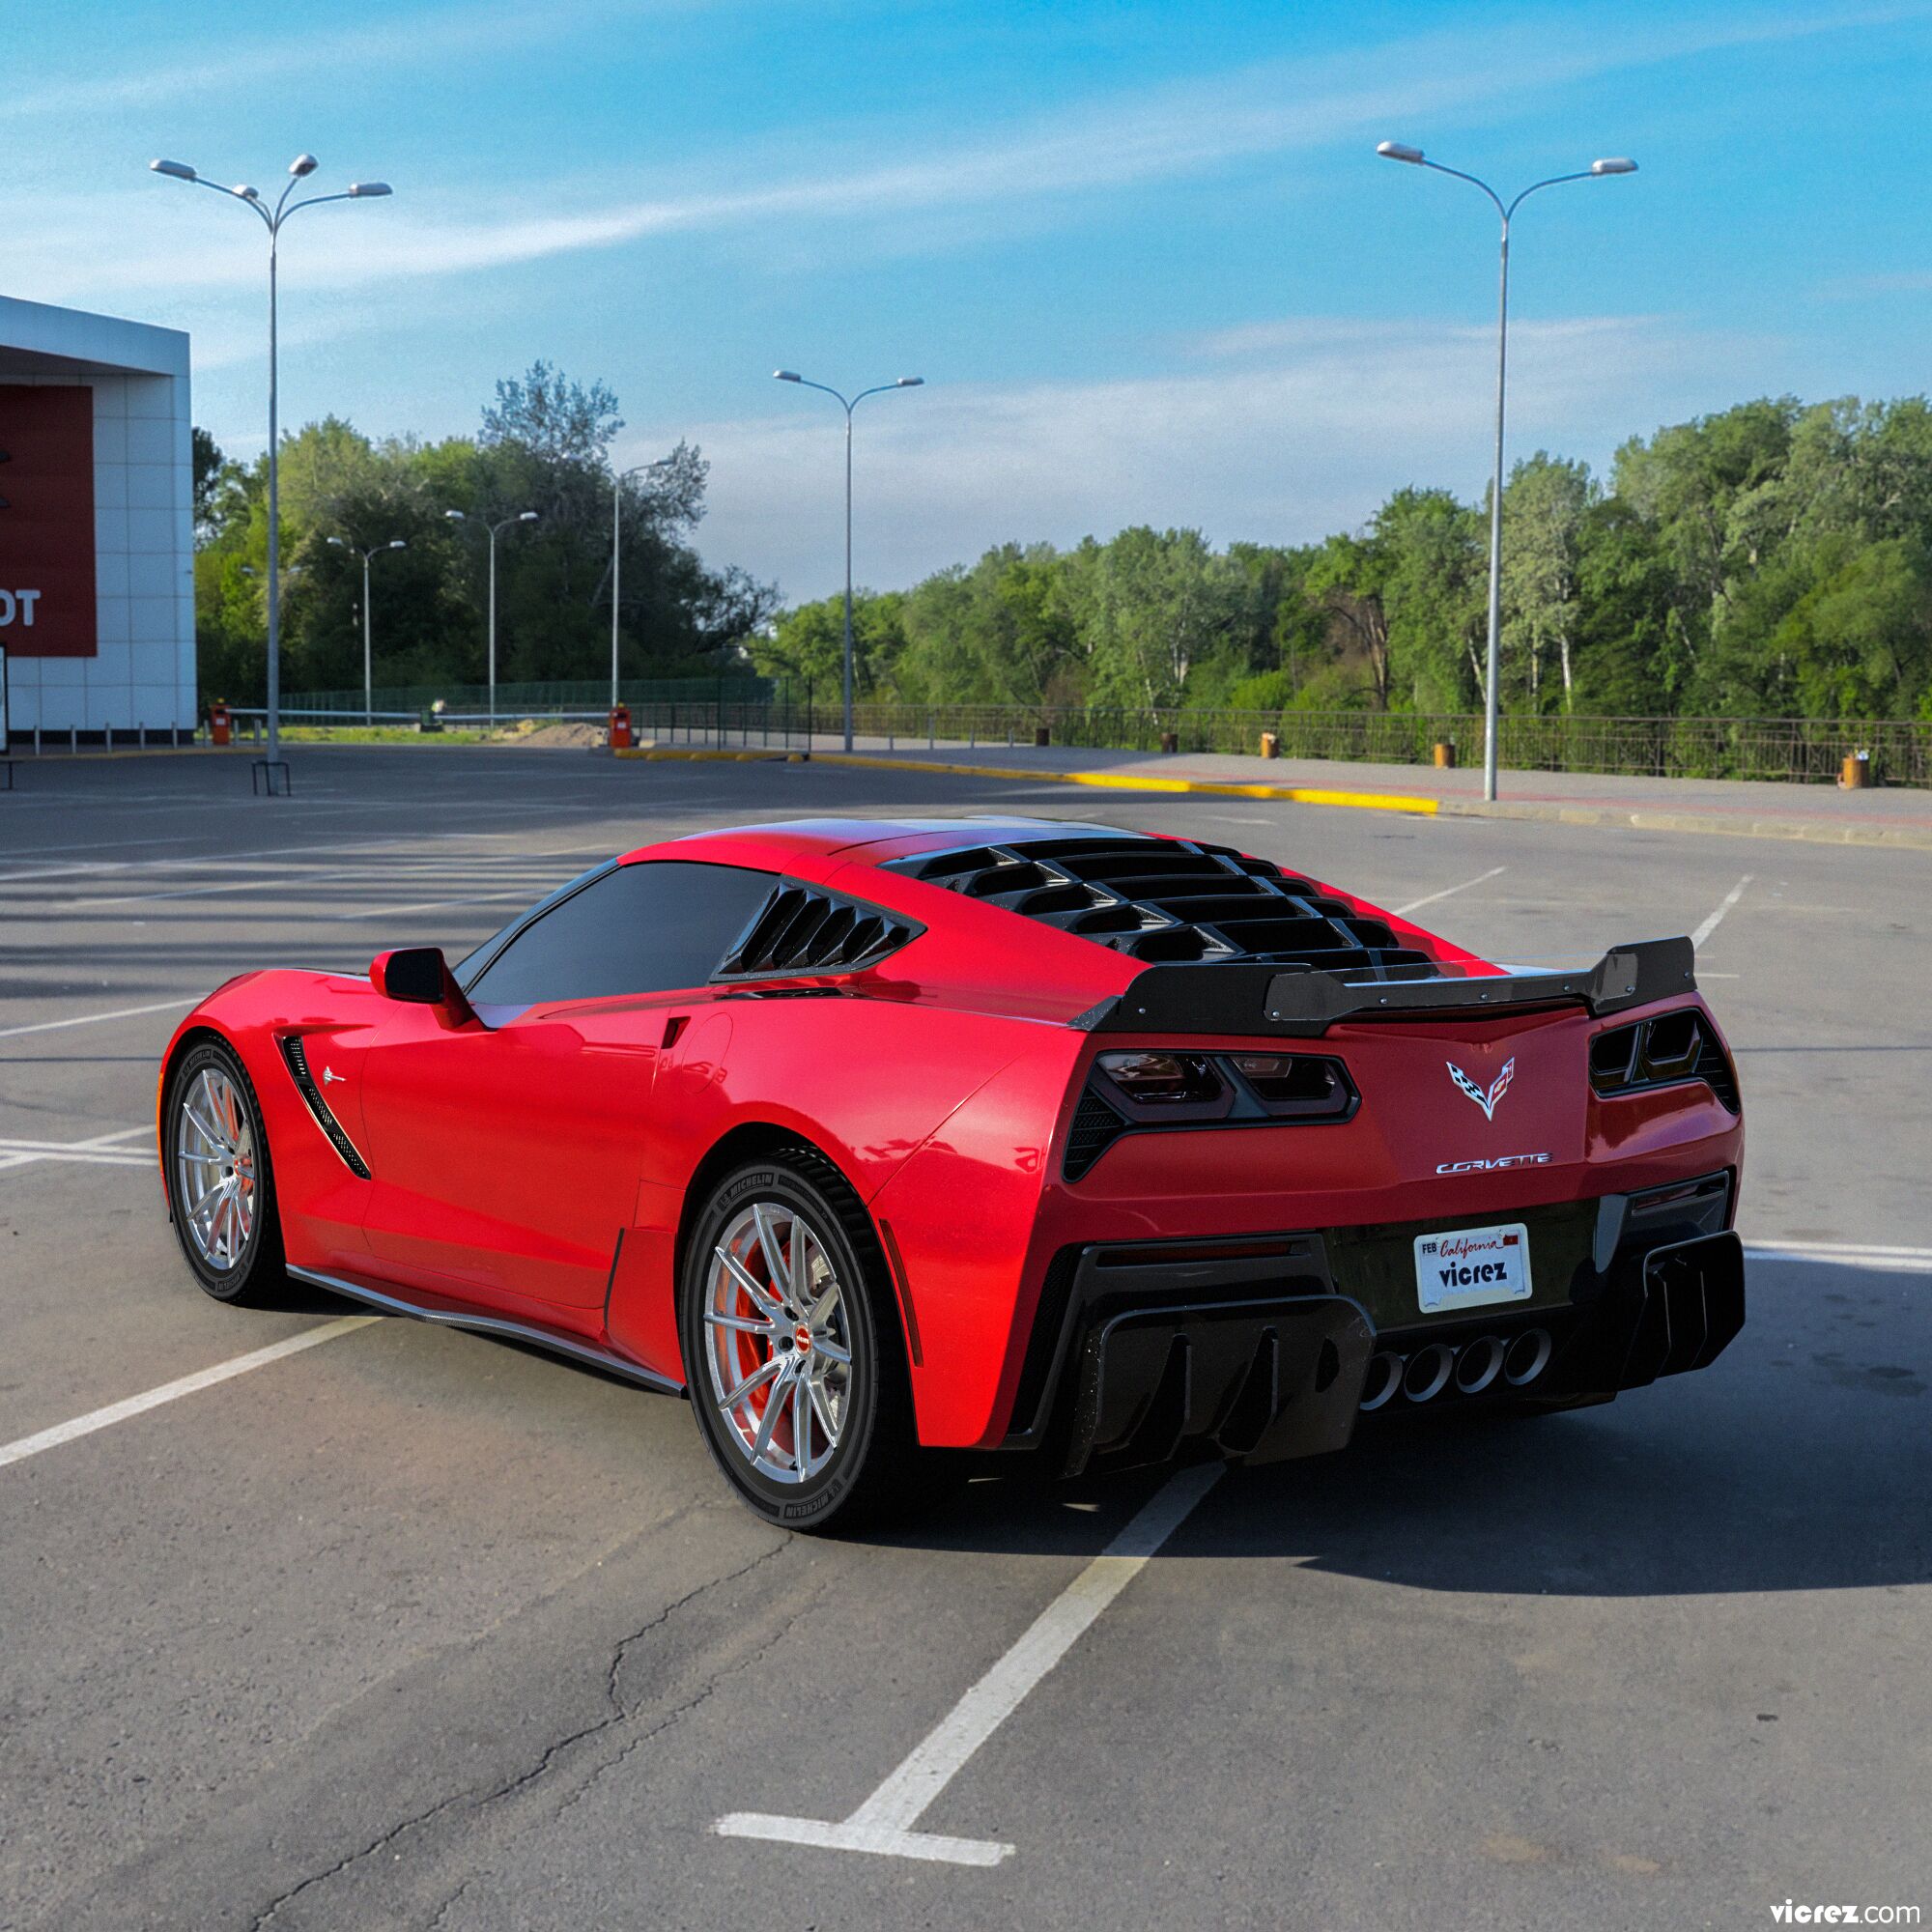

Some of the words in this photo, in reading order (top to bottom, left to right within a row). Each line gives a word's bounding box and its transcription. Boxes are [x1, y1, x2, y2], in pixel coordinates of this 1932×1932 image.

[1435, 1152, 1553, 1175] CORVETTE
[729, 1173, 773, 1198] MICHELIN
[1422, 1242, 1437, 1254] FEB
[1439, 1237, 1504, 1259] California
[1438, 1261, 1508, 1288] vicrez
[786, 1492, 829, 1517] MICHELIN
